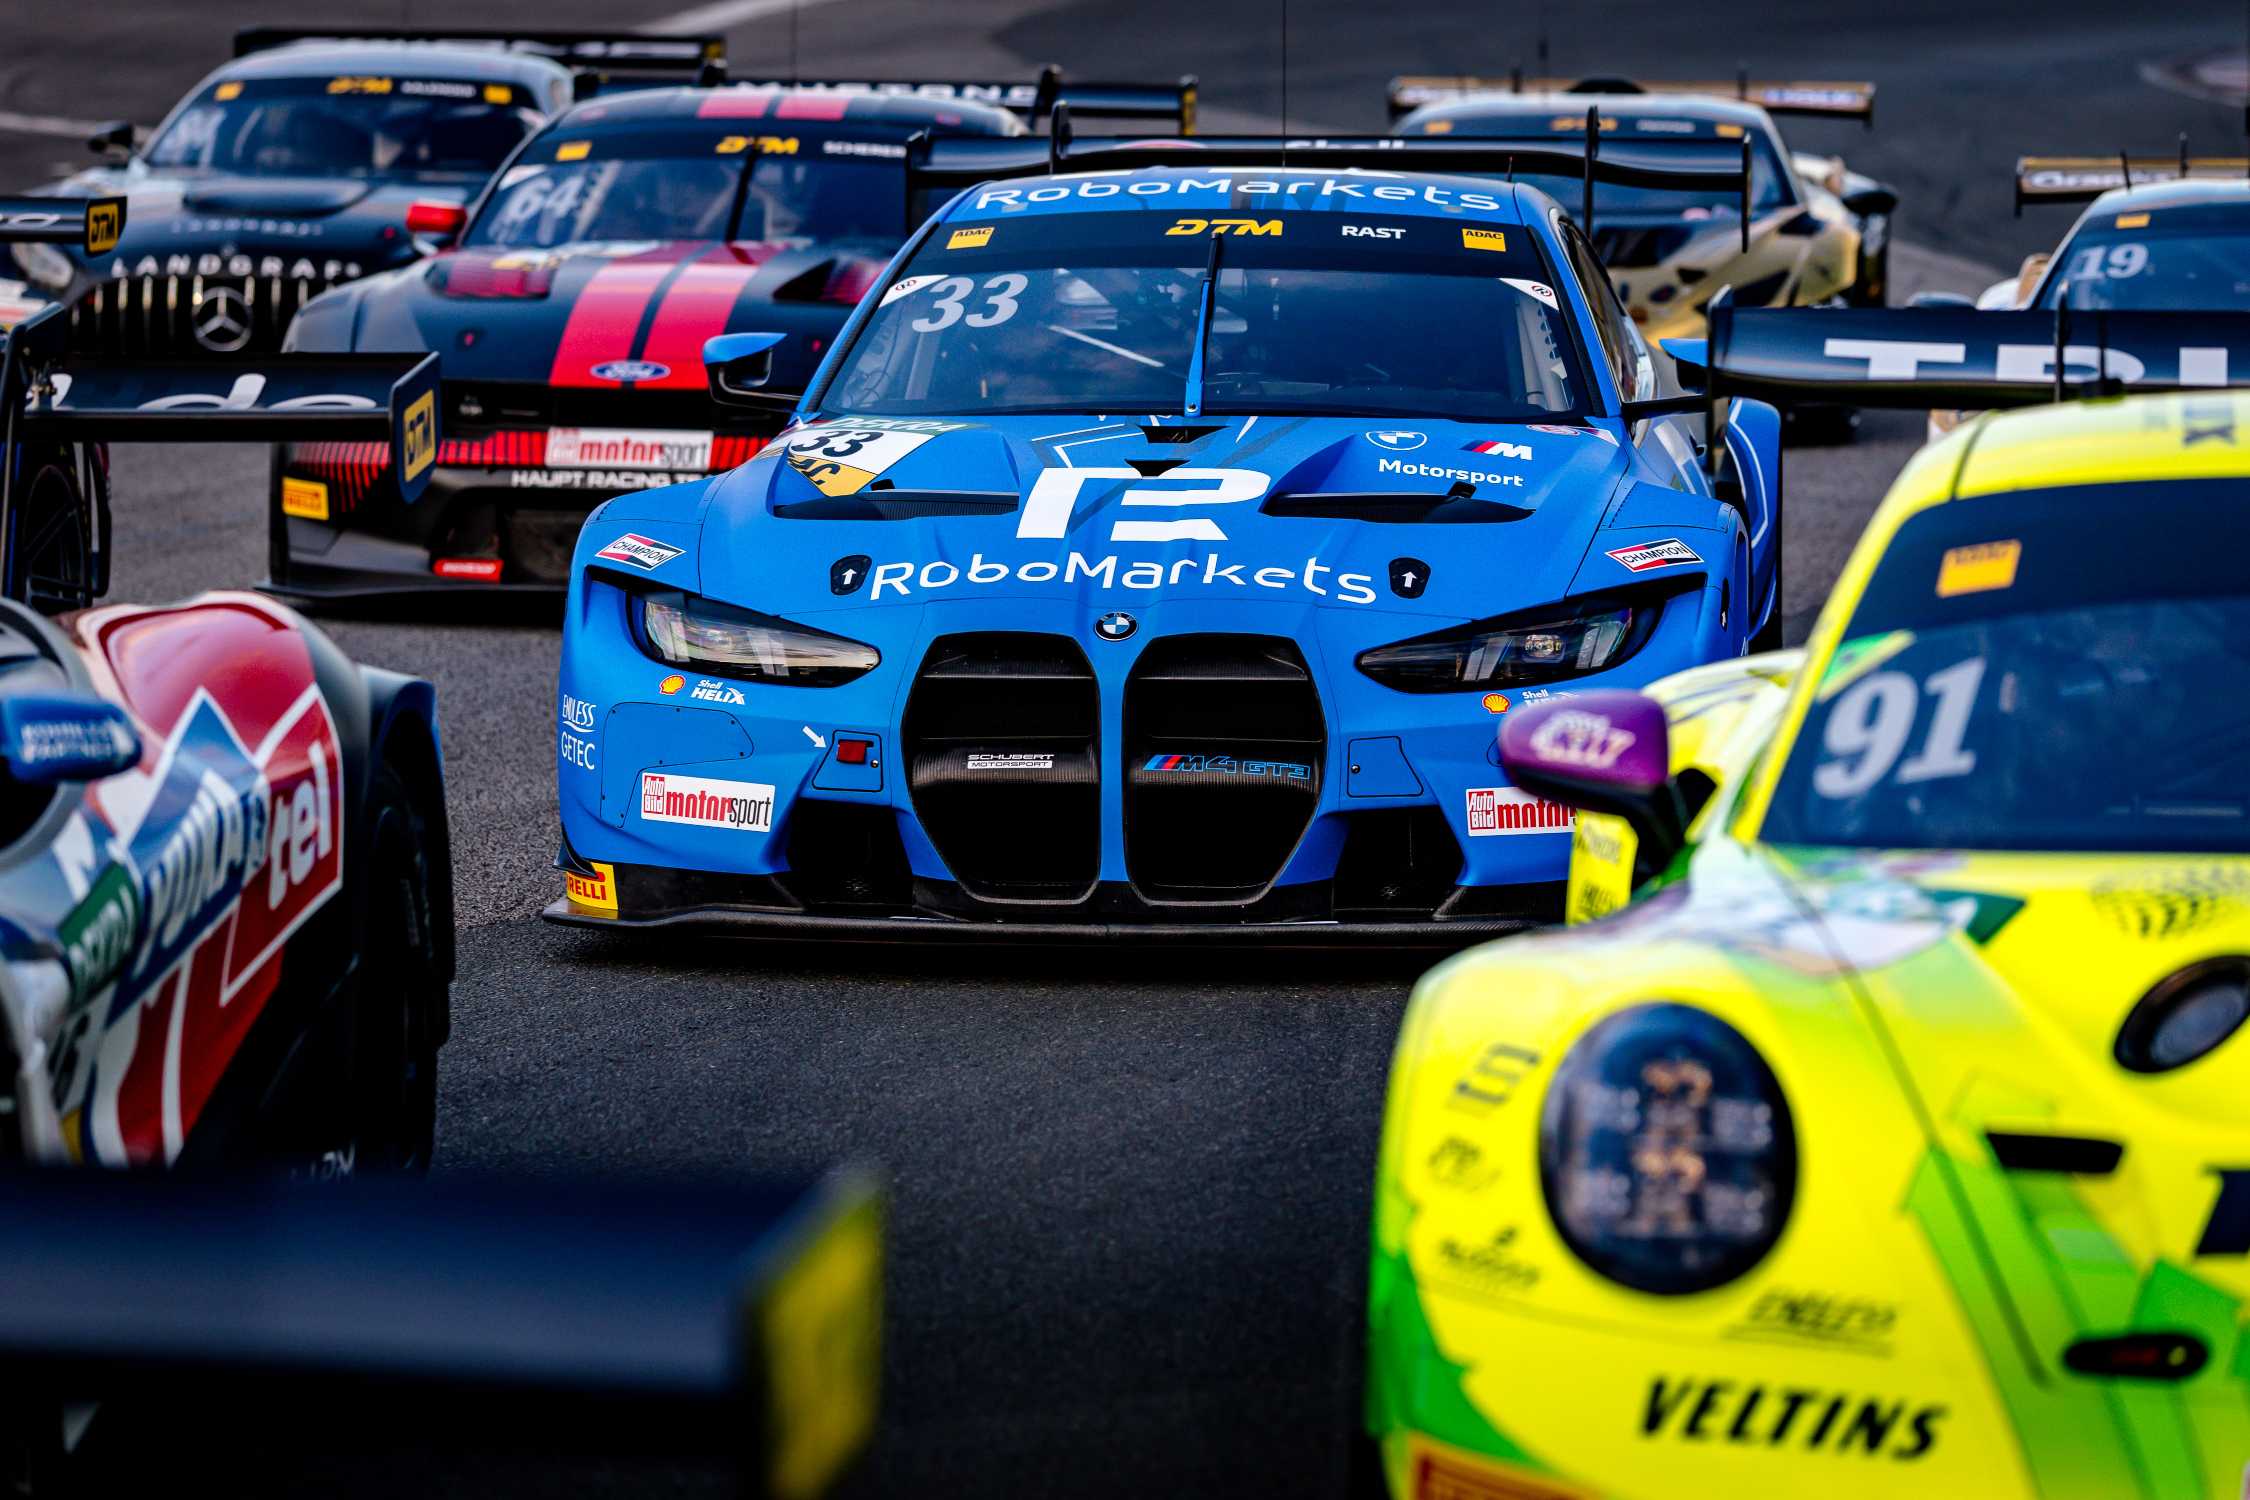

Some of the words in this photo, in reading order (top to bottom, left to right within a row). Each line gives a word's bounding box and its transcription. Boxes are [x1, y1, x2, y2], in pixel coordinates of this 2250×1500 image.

[500, 175, 586, 225] 64
[976, 178, 1501, 212] RoboMarkets
[955, 228, 992, 238] ADAC
[1165, 219, 1284, 236] DTM
[1342, 224, 1407, 240] RAST
[1465, 229, 1504, 241] ADAC
[2070, 242, 2149, 280] 19
[911, 273, 1029, 334] 33
[790, 430, 885, 458] 33
[511, 470, 583, 488] HAUPT
[1378, 458, 1524, 487] Motorsport
[612, 541, 669, 562] CHAMPION
[1622, 546, 1689, 563] CHAMPION
[870, 552, 1378, 605] RoboMarkets
[697, 679, 723, 689] Shell
[690, 686, 746, 706] HELIX
[1522, 689, 1549, 700] Shell
[562, 694, 597, 728] ENDLESS
[1812, 656, 1988, 799] 91
[561, 731, 596, 770] GETEC
[967, 753, 1055, 761] SCHUBERT
[971, 760, 1049, 768] MOTORSPORT
[1242, 760, 1312, 780] GT3
[644, 776, 665, 795] Auto
[644, 795, 665, 813] Bild
[665, 790, 772, 827] motorsport
[1468, 792, 1494, 811] Auto
[1470, 811, 1494, 830] Bild
[567, 876, 608, 901] RELLI
[1640, 1376, 1952, 1462] VELTINS
